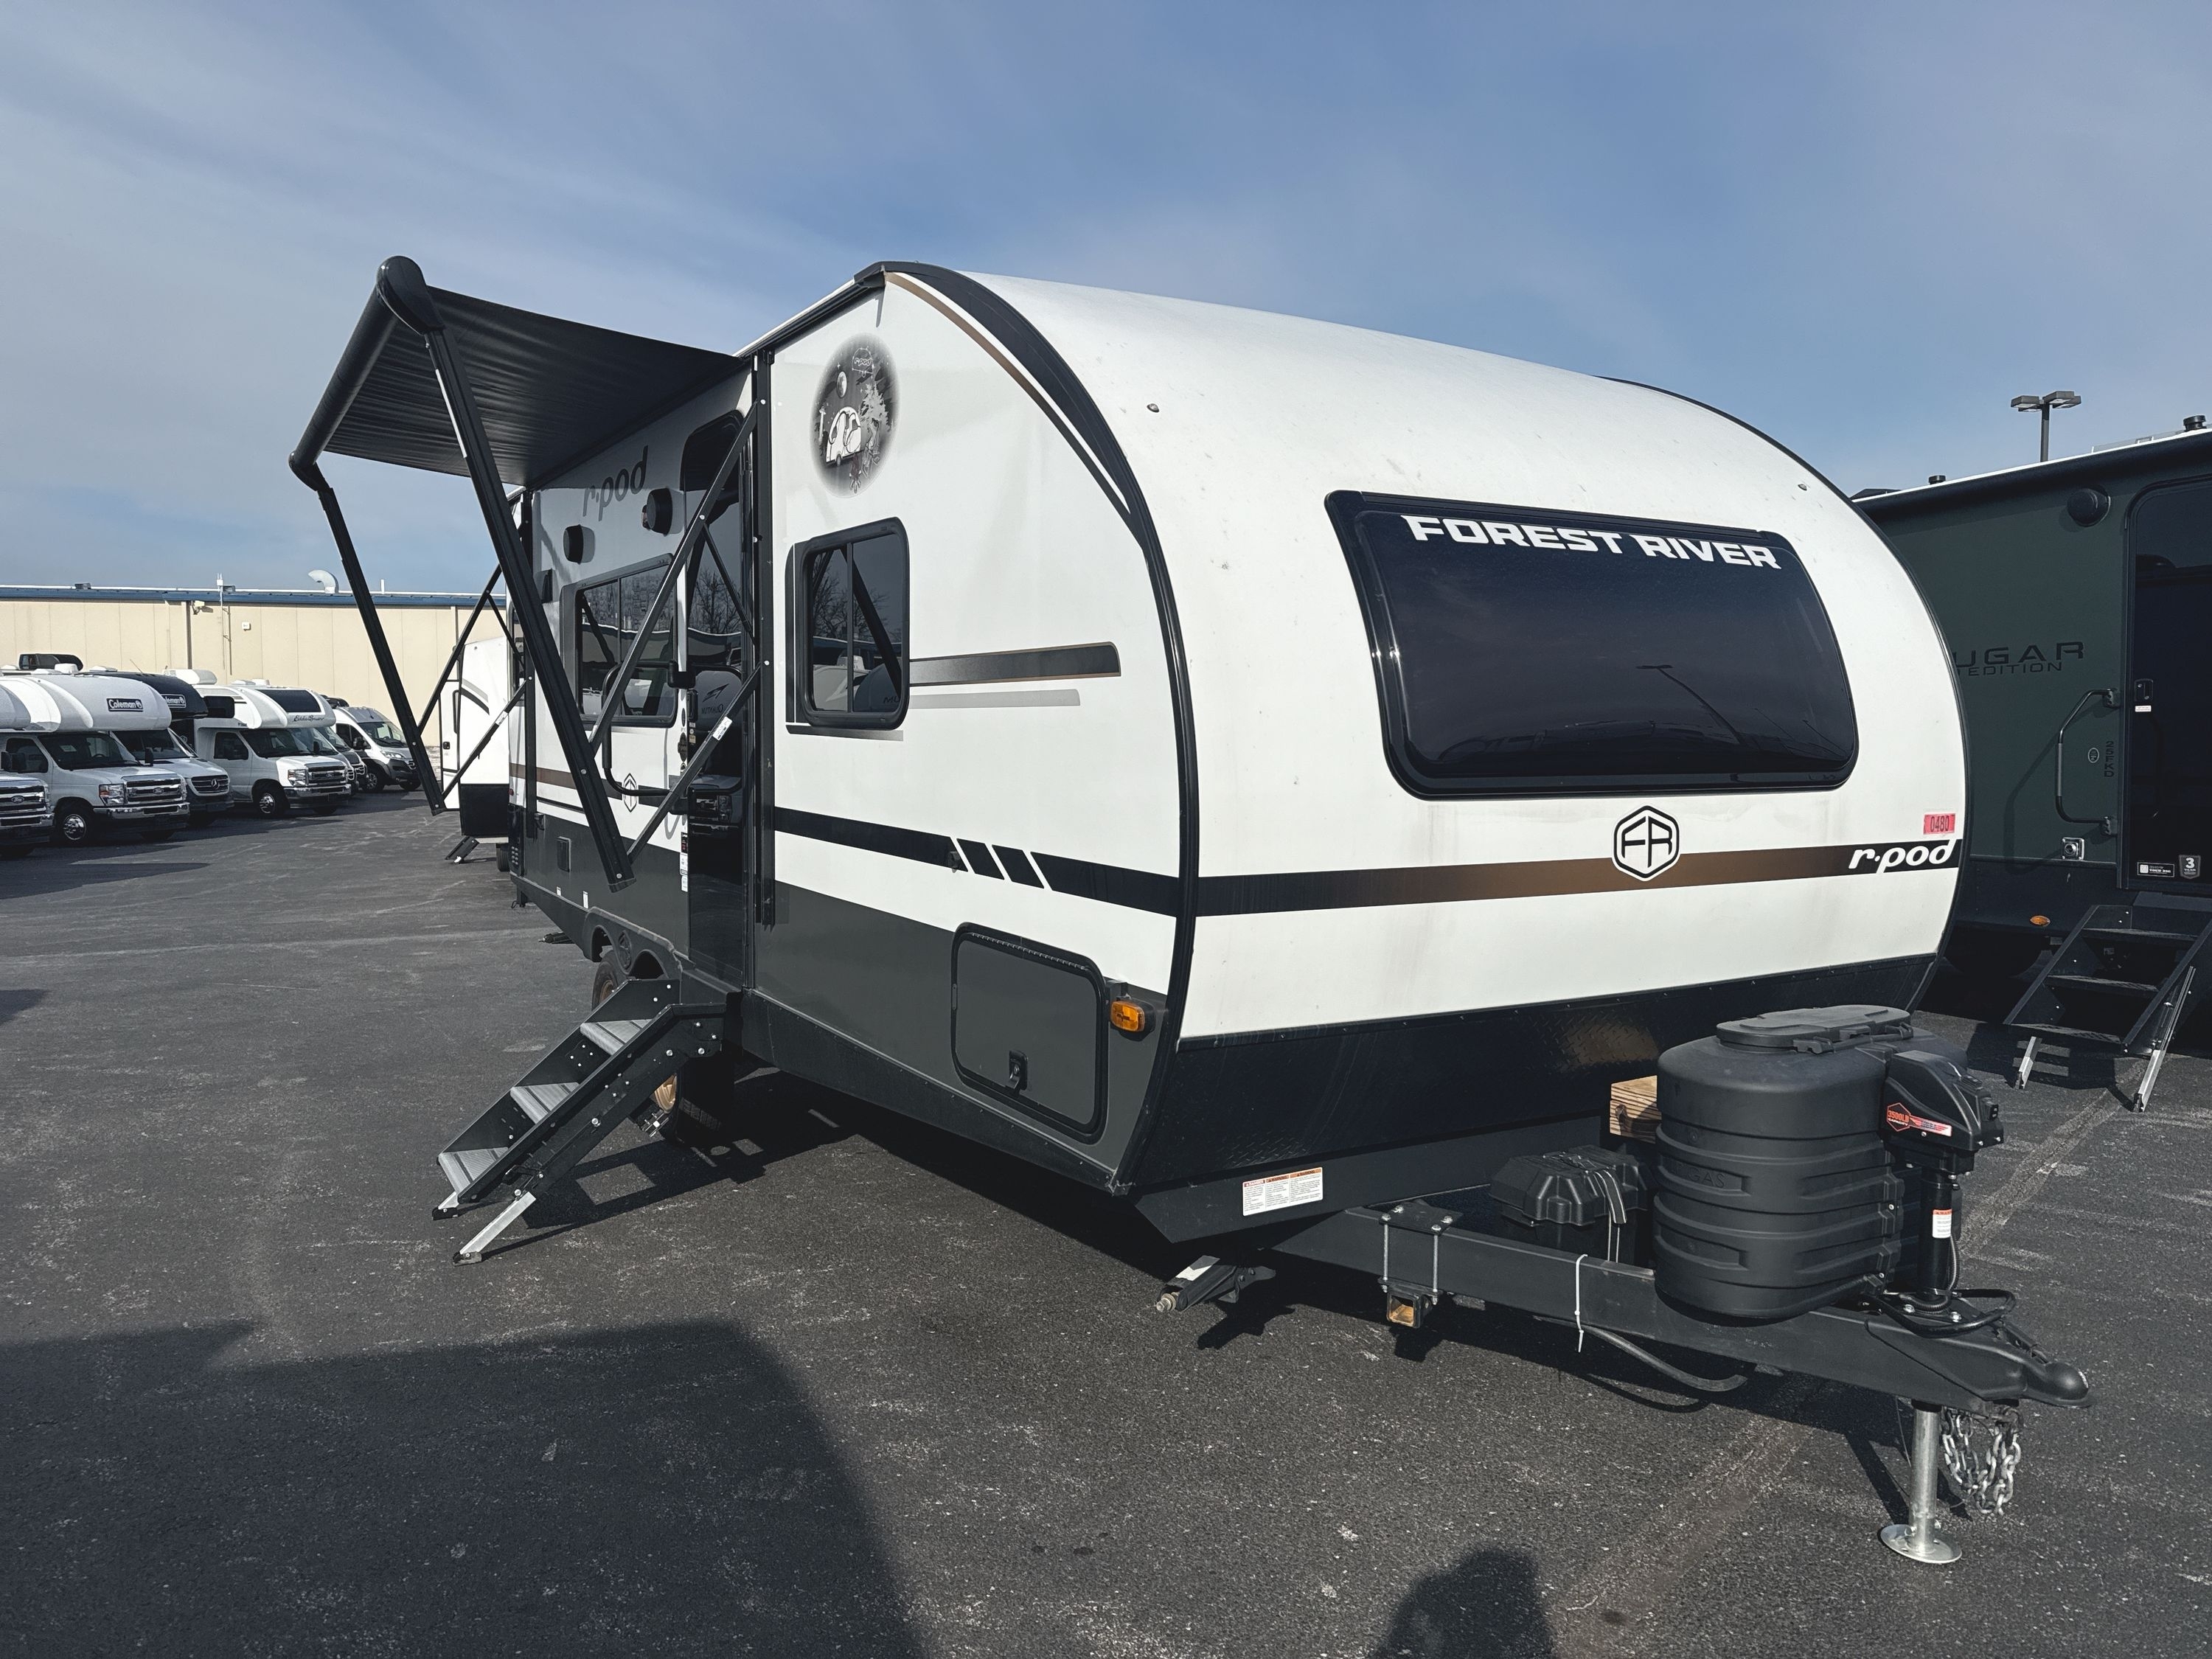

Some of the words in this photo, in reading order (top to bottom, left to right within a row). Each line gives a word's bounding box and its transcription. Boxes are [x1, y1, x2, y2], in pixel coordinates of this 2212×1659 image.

[1401, 515, 1623, 554] FOREST
[1630, 534, 1781, 569] RIVER
[1953, 641, 2084, 667] UGAR
[1969, 662, 2062, 676] EDITION
[108, 699, 137, 709] Coleman
[1930, 815, 1950, 832] 0480
[2185, 857, 2195, 869] 3
[1688, 1167, 1726, 1189] GAS
